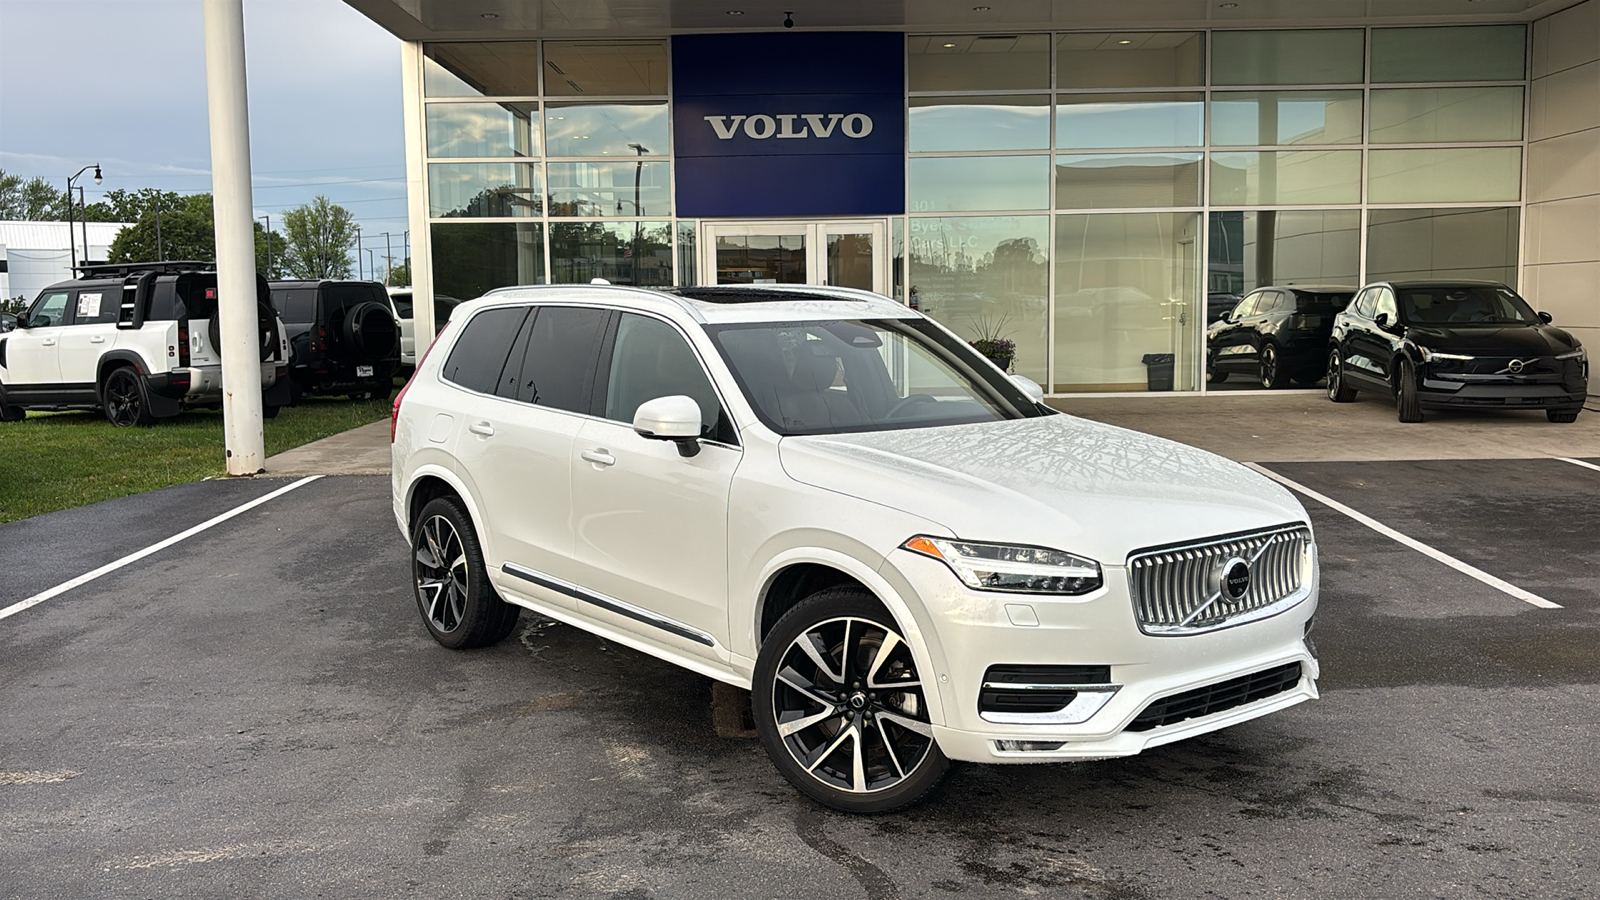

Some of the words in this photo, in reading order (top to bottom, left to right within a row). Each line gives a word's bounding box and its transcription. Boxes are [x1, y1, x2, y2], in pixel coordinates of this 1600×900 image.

[704, 113, 873, 139] VOLVO
[911, 200, 934, 211] 301
[911, 220, 952, 234] Byers
[950, 235, 978, 248] LLC
[1229, 576, 1249, 584] VOLVO
